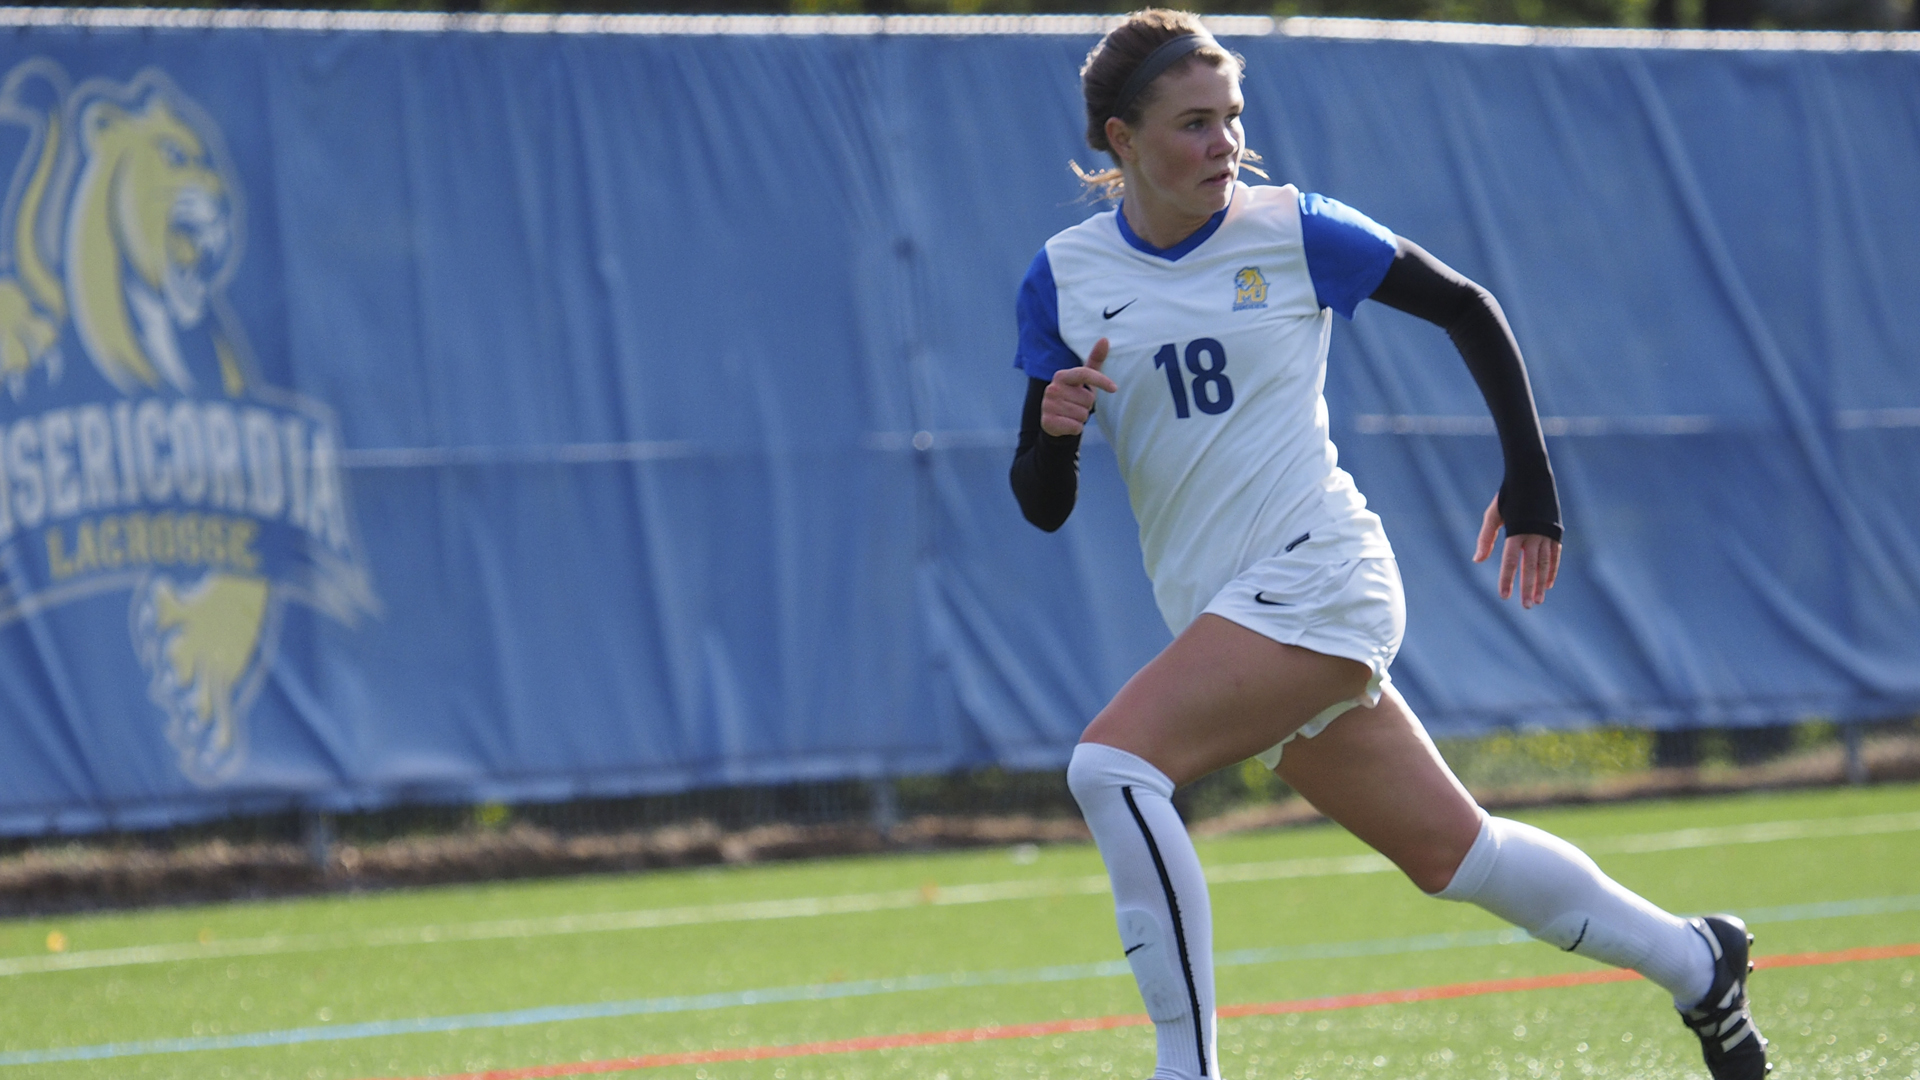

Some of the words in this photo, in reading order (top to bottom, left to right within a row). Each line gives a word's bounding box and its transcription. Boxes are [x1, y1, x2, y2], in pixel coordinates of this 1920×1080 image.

[1235, 284, 1269, 303] MU
[1153, 337, 1234, 419] 18
[46, 510, 262, 579] LACROSSE
